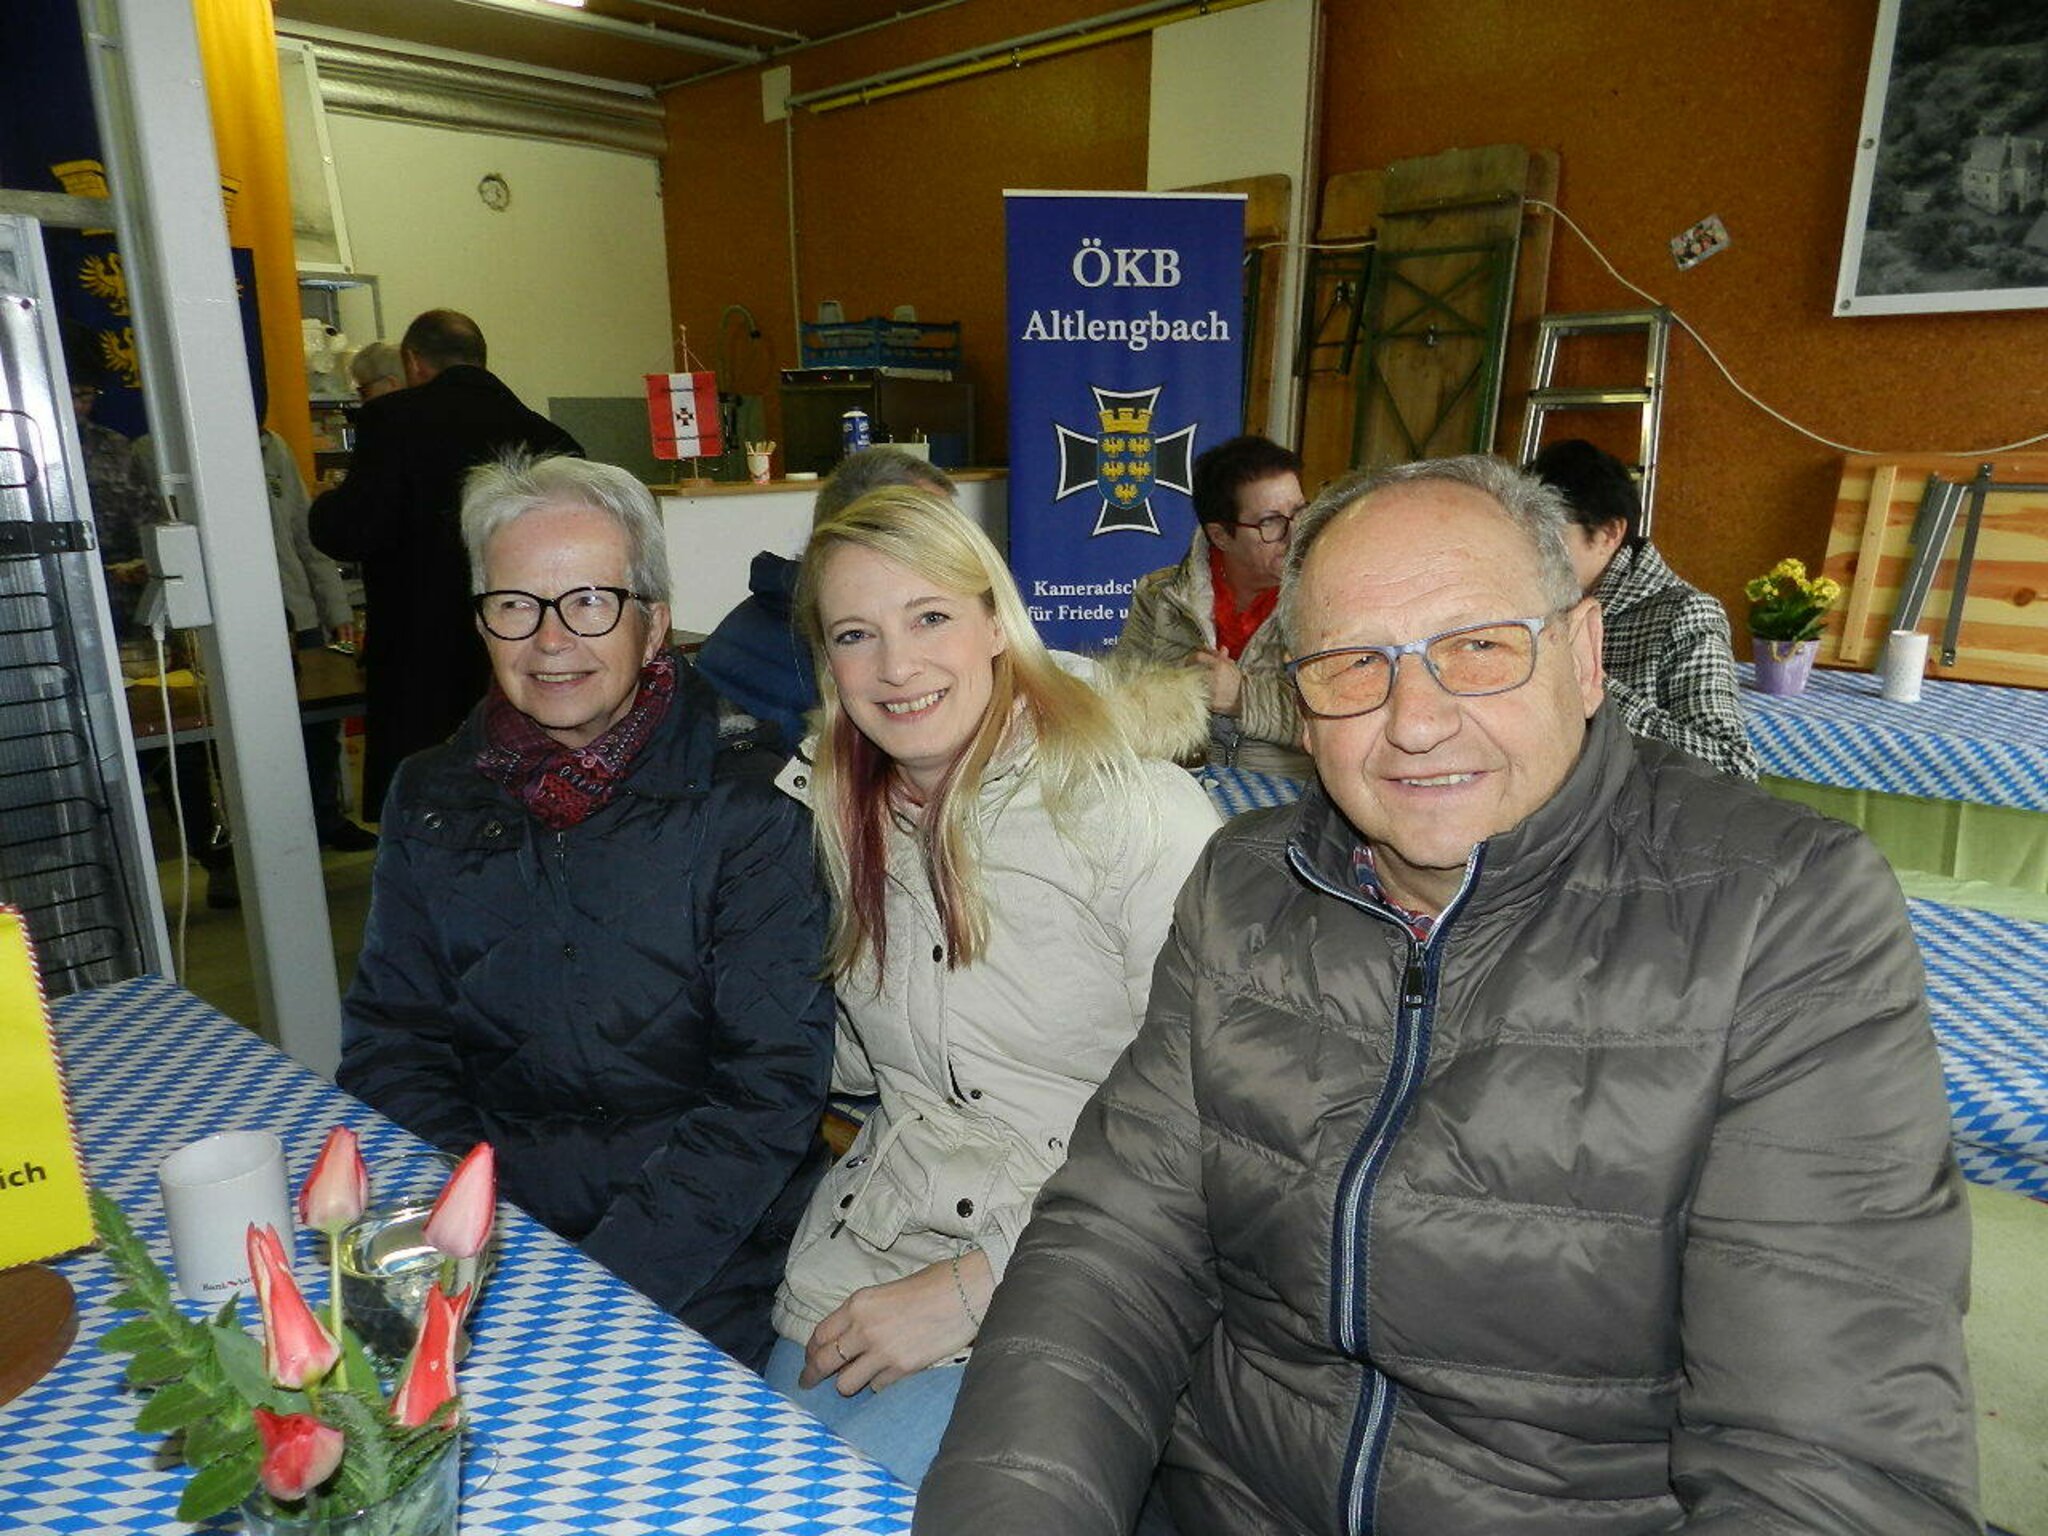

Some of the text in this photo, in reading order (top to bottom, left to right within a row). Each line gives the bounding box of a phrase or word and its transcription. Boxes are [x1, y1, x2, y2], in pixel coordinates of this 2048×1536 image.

[1072, 237, 1182, 288] ÖKB
[1021, 309, 1231, 352] Altlengbach
[1028, 606, 1052, 621] für
[1058, 604, 1114, 620] Friede
